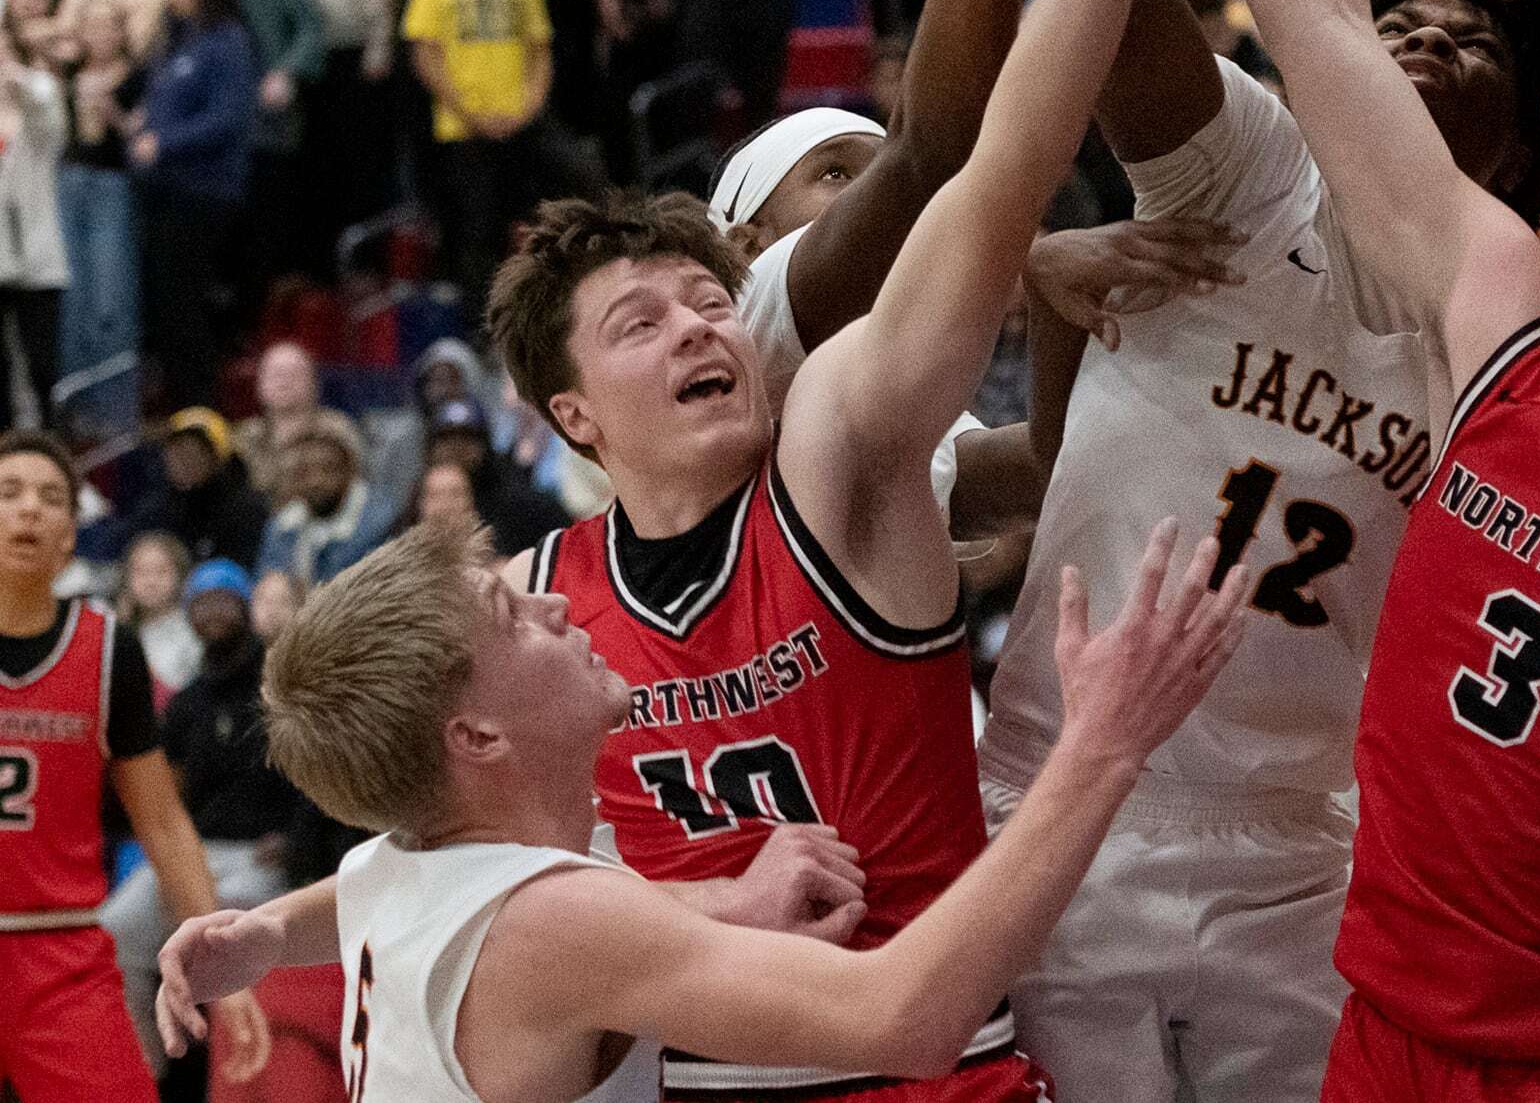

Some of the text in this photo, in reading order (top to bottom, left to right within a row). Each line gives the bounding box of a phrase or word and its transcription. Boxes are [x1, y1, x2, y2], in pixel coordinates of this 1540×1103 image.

[1207, 457, 1357, 627] 12
[609, 621, 830, 734] RTHWEST
[632, 735, 826, 841] 10
